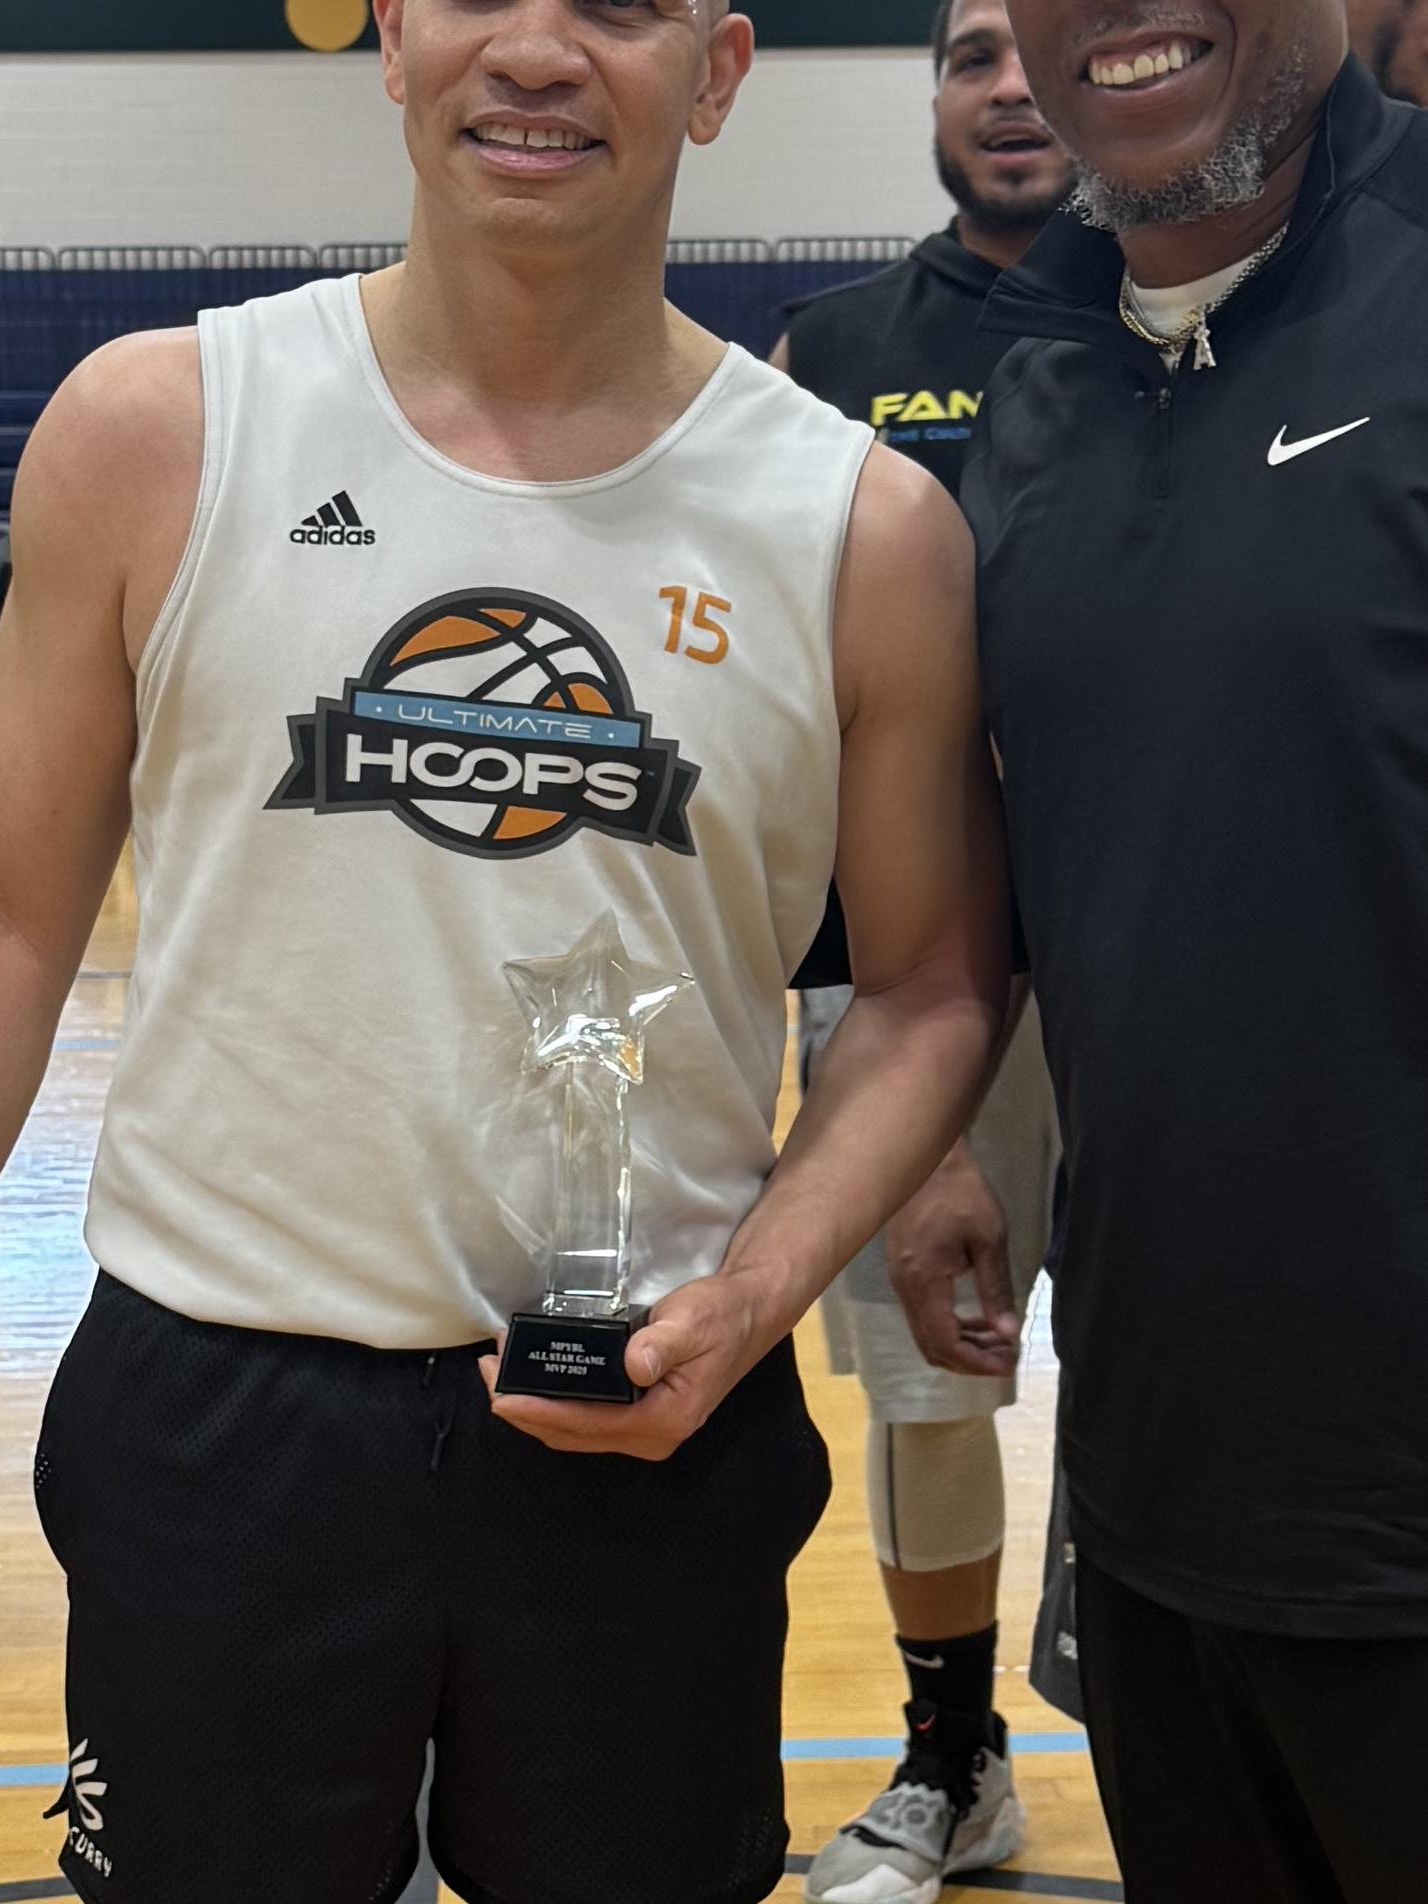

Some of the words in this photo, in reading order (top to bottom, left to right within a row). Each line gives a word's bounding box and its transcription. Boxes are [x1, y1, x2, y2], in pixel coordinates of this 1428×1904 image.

[290, 525, 376, 546] adidas
[658, 585, 732, 665] 15
[398, 704, 593, 739] ULTIMATE
[345, 733, 642, 811] HOOPS
[575, 1354, 607, 1366] GAME
